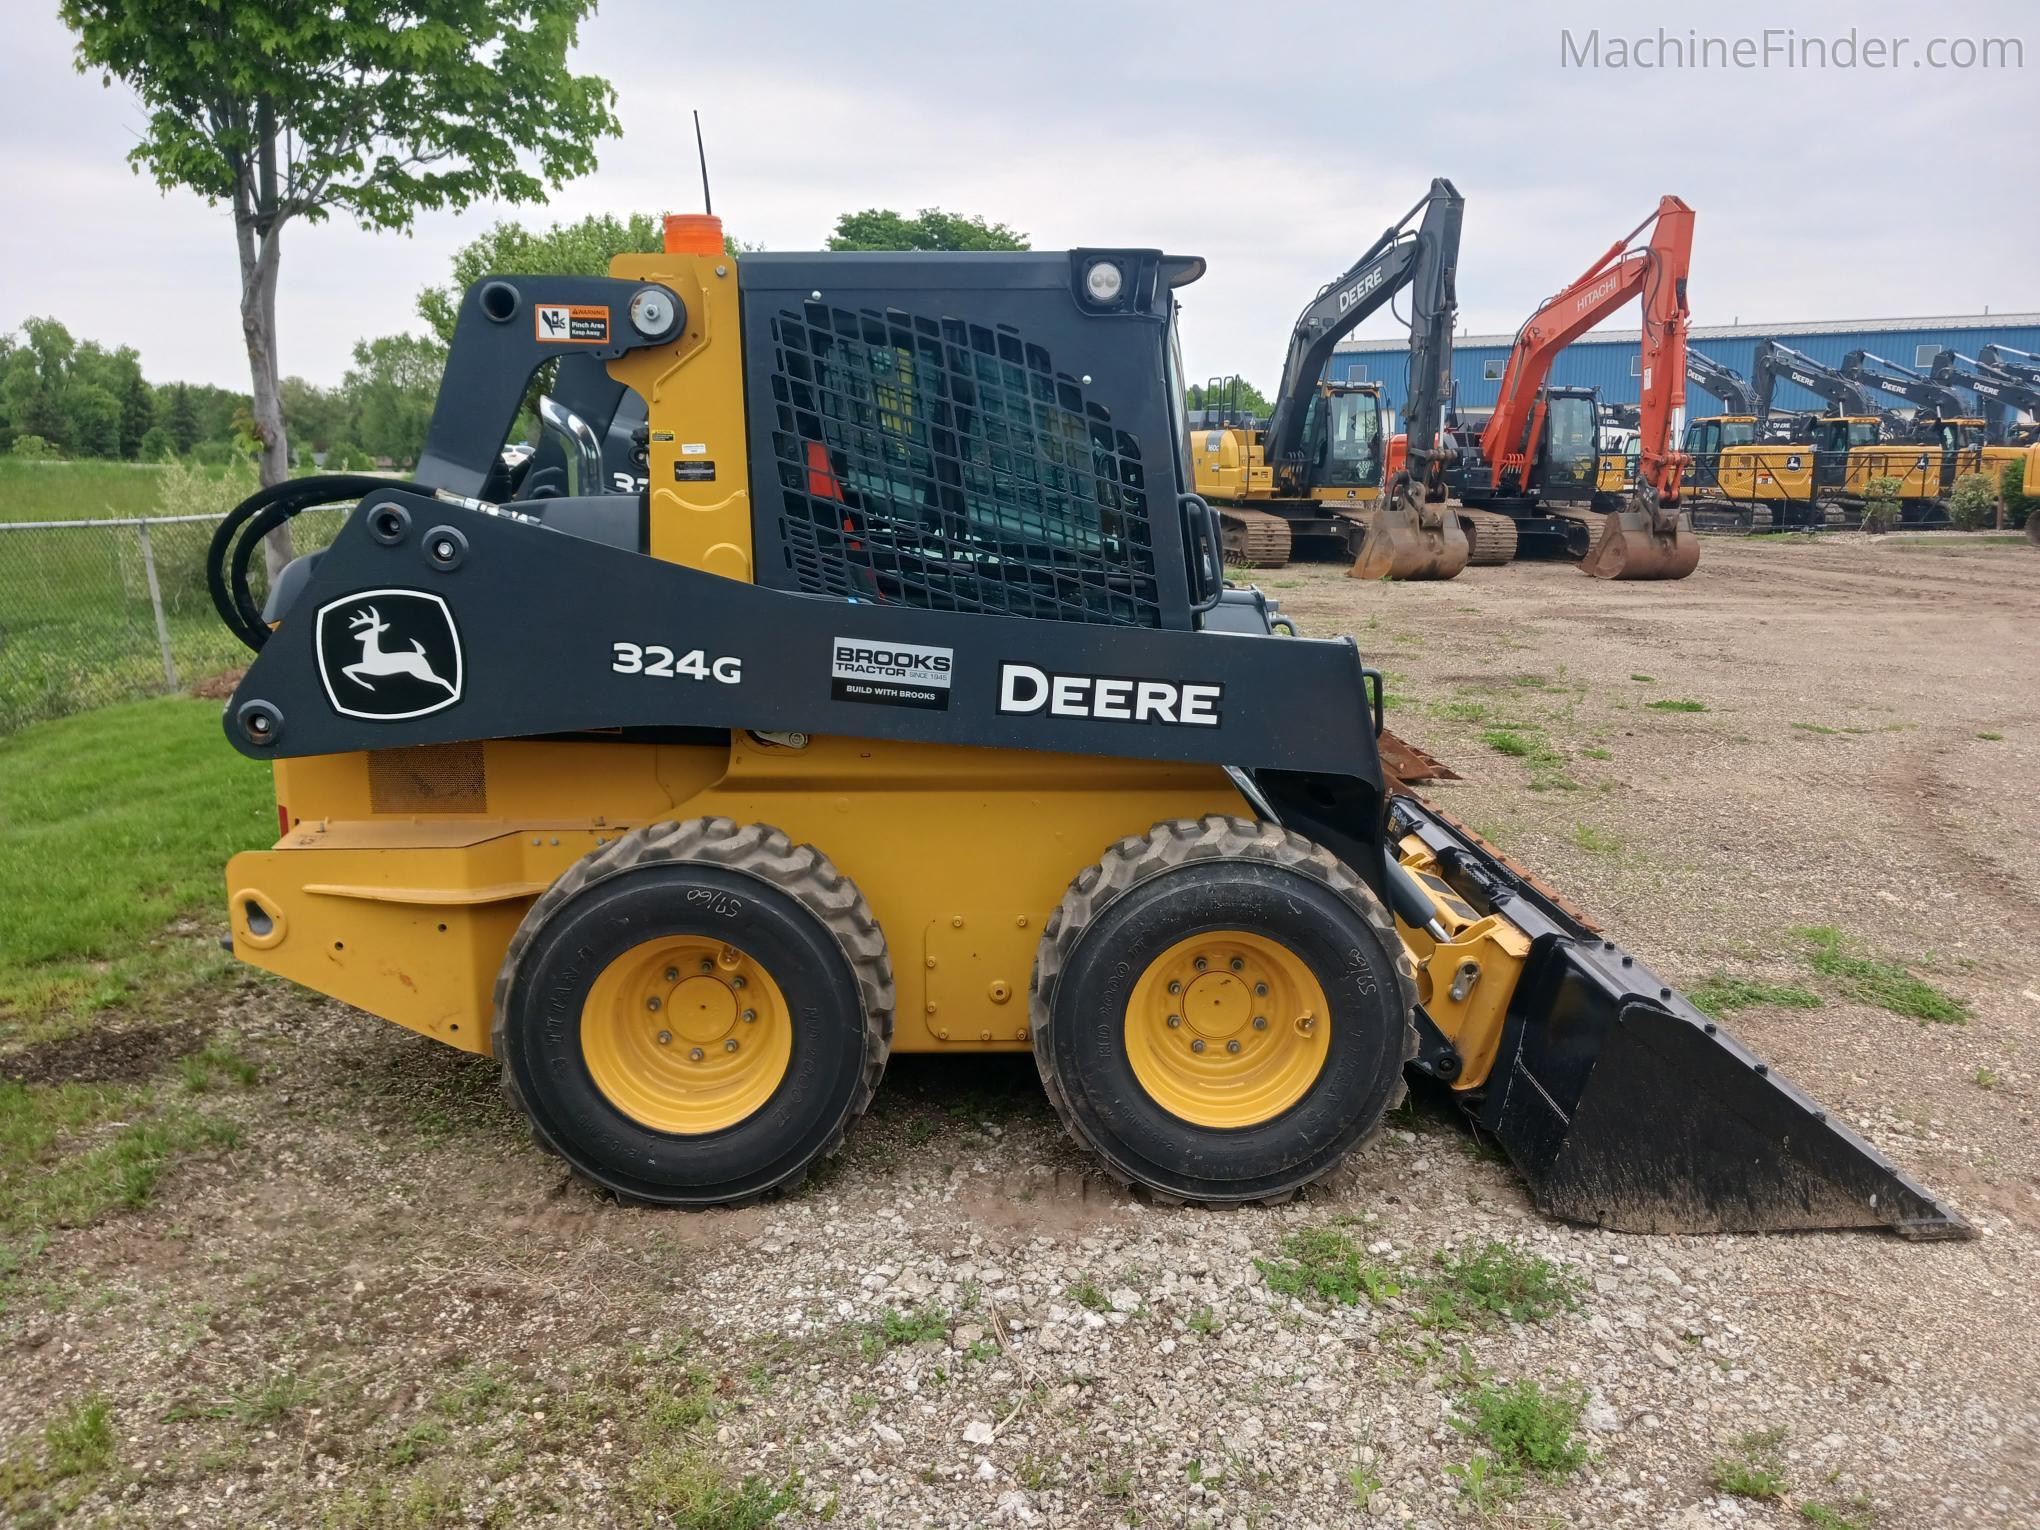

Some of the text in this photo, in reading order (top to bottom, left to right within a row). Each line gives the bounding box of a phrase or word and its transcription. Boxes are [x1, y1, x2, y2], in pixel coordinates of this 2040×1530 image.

[1339, 265, 1383, 313] DEERE
[1577, 276, 1616, 312] HITACHI
[571, 321, 590, 329] Pinch
[1687, 368, 1707, 384] DEERE
[1791, 371, 1815, 387] DEERE
[1881, 381, 1908, 395] DEERE
[1973, 382, 2000, 396] DEERE
[611, 641, 743, 685] 324G
[836, 646, 951, 672] BROOKS
[835, 662, 948, 681] TRACTOR SINCE 1945
[846, 684, 936, 701] BUILD WITH BROOKS
[1000, 663, 1222, 726] DEERE
